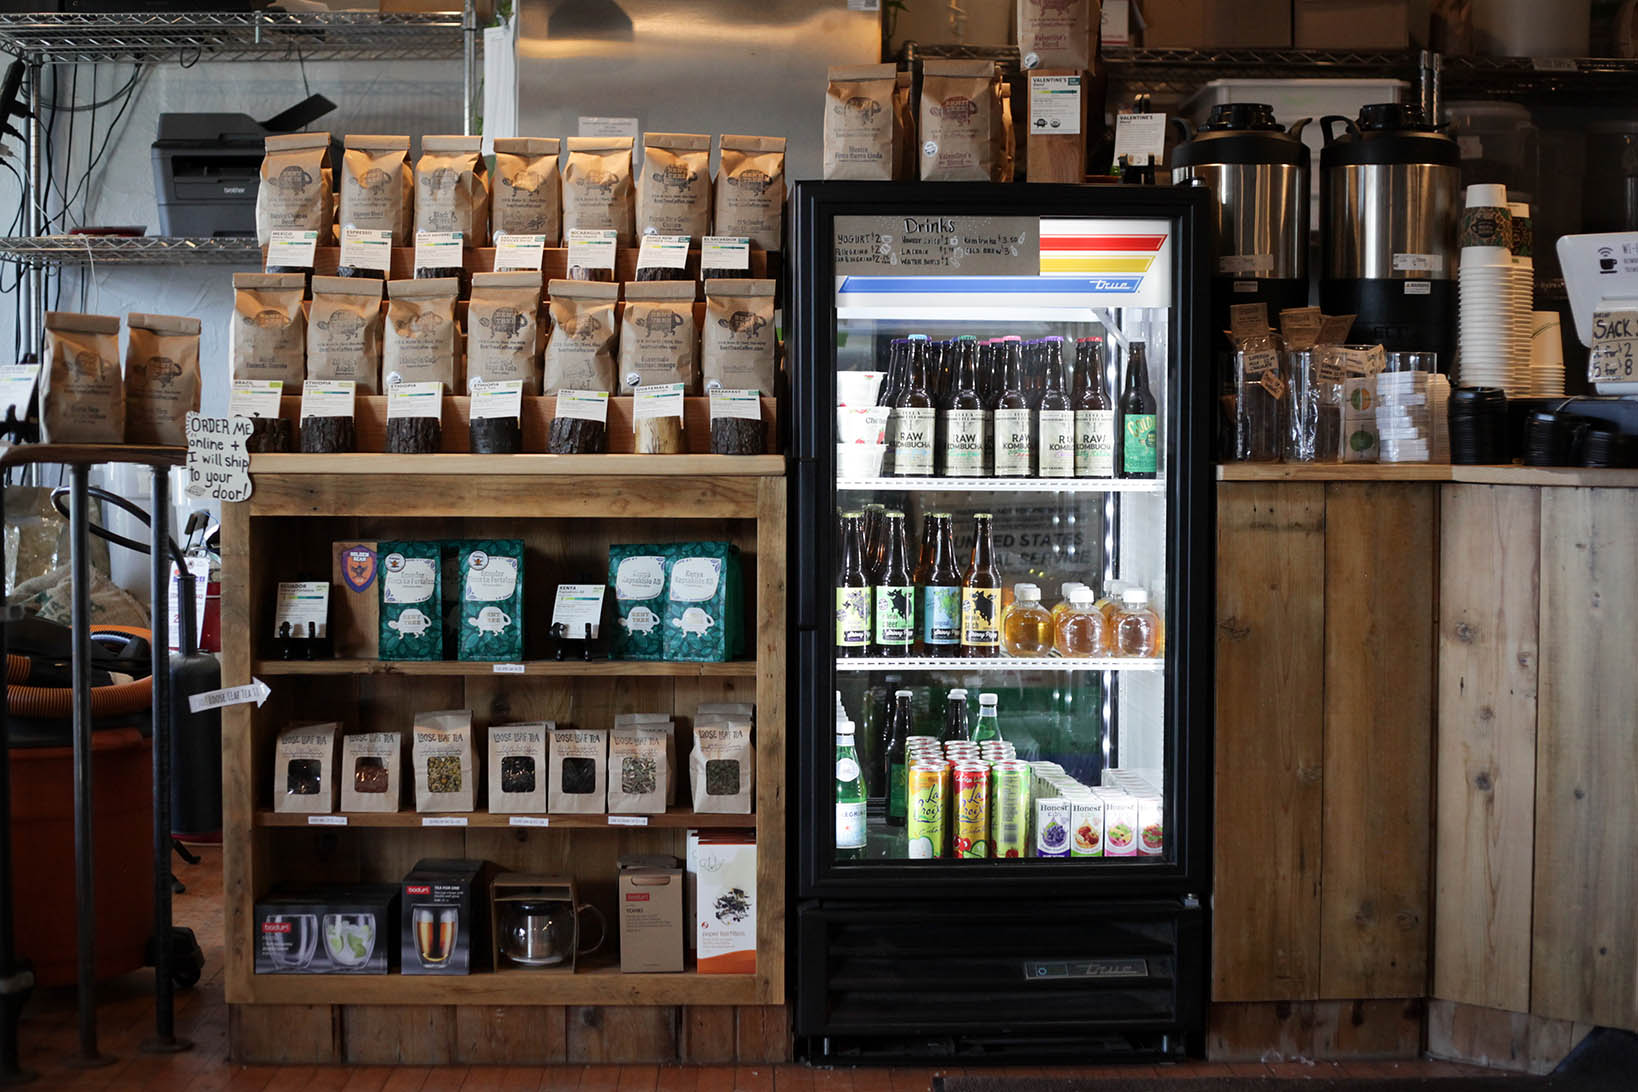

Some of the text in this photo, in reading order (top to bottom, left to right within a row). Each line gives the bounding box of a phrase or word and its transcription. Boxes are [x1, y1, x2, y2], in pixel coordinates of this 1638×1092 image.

[904, 217, 955, 234] Drinks
[838, 234, 869, 244] YOGURT
[1088, 279, 1131, 290] True
[1593, 319, 1633, 339] SACK
[1592, 361, 1602, 378] 5
[191, 417, 252, 437] ORDER ME
[900, 432, 924, 442] RAW
[189, 437, 225, 451] online
[188, 451, 249, 473] I will ship
[190, 466, 233, 489] to your
[212, 482, 249, 501] door!
[1020, 533, 1085, 548] STATES
[417, 733, 436, 743] LOOSE
[494, 732, 512, 743] LOOSE
[555, 733, 574, 743] LOOSE
[698, 729, 718, 739] LOOSE
[1040, 803, 1070, 812] Honest
[1073, 803, 1102, 812] Honest
[264, 923, 290, 931] bodum
